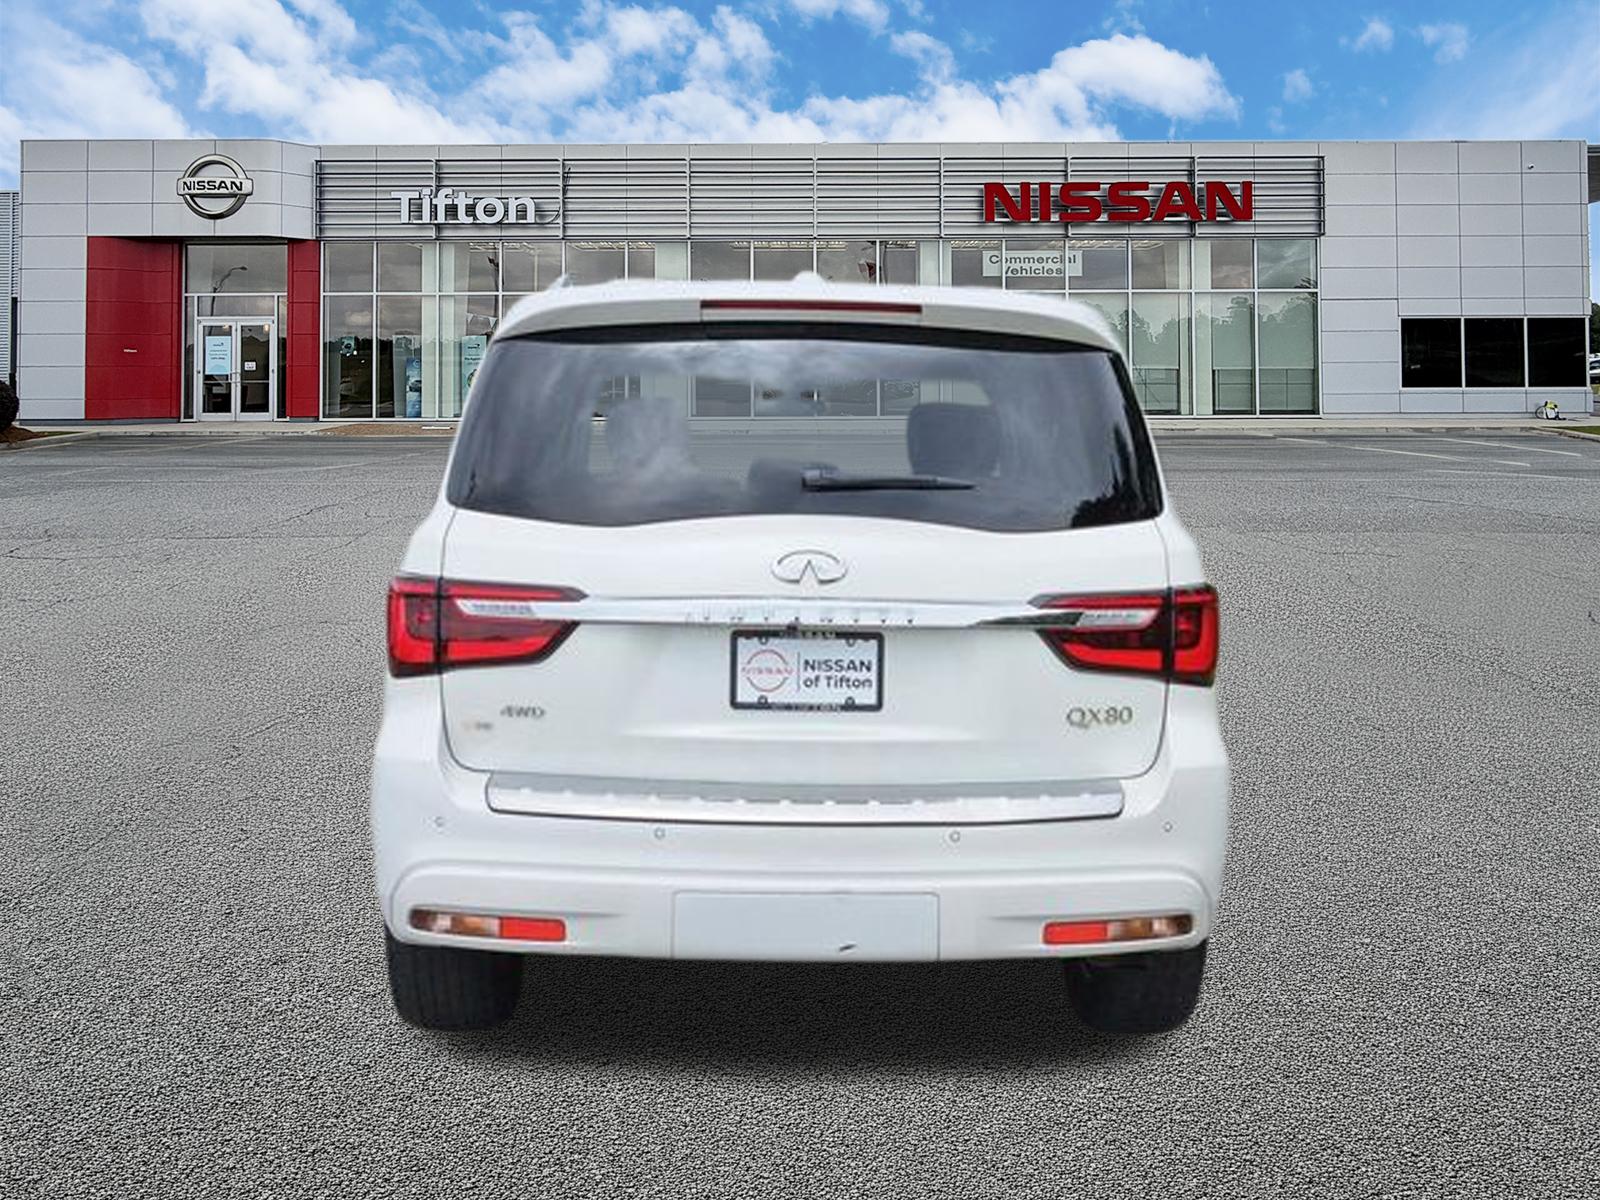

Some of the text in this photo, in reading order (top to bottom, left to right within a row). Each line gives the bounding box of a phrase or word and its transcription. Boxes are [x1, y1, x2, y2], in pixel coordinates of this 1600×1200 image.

[182, 180, 243, 192] NISSAN
[391, 188, 536, 224] Tifton
[983, 181, 1253, 222] NISSAN
[803, 659, 872, 672] NISSAN
[803, 675, 873, 688] of Tifton
[1066, 706, 1133, 729] QX80
